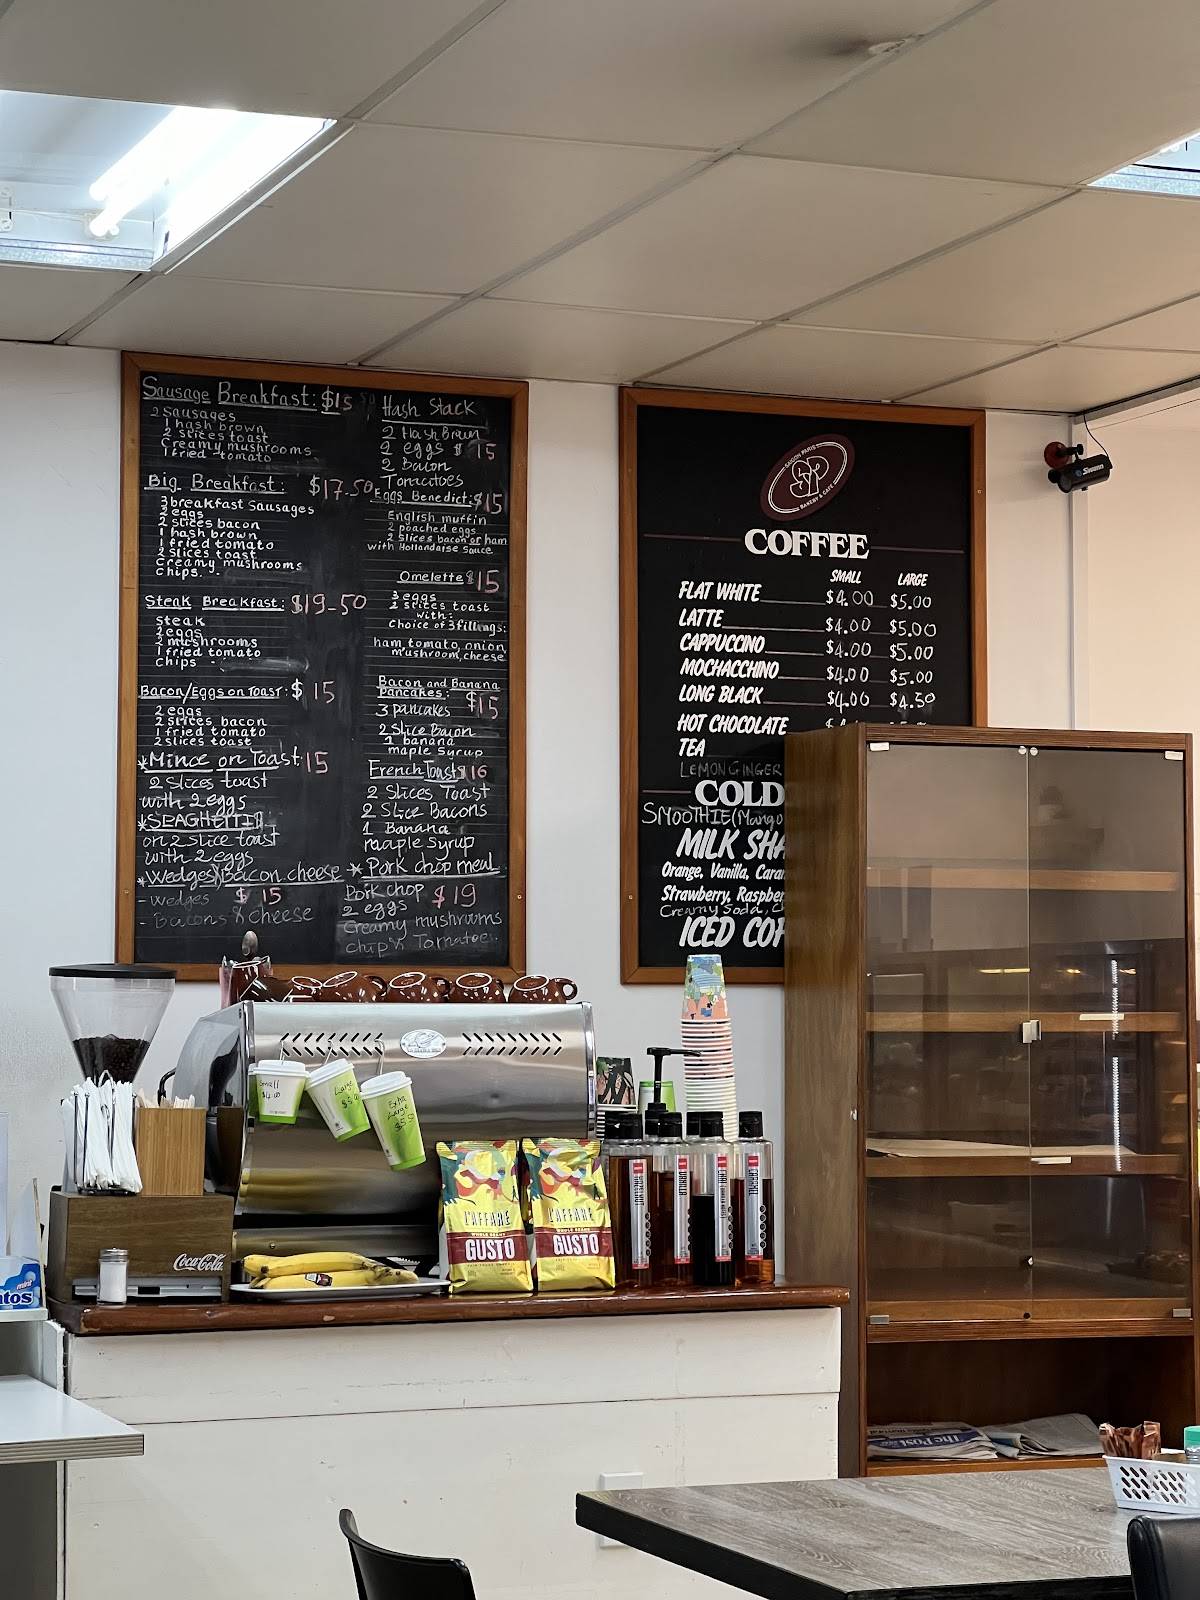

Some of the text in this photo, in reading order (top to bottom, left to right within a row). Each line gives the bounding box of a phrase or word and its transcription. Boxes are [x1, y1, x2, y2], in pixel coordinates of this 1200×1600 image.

[142, 376, 210, 402] Sausage
[382, 395, 477, 419] Hash Stack
[176, 419, 212, 430] hash
[382, 425, 437, 440] 2 Hash
[179, 428, 268, 443] slices toast
[171, 449, 207, 459] fried
[227, 442, 312, 456] mushrooms
[380, 441, 444, 460] 2 eggs
[382, 457, 452, 472] 2 Bacon
[1082, 463, 1104, 476] Swann
[148, 472, 177, 493] Big
[380, 473, 464, 489] Tomatoes
[170, 497, 244, 511] breakfast
[374, 488, 403, 504] Eggs
[171, 508, 204, 520] eggs
[388, 511, 487, 525] English muffin
[171, 517, 260, 530] slices bacon
[399, 524, 476, 538] poached eggs
[170, 527, 258, 540] hash brown
[399, 533, 508, 545] slices bacon ham
[169, 538, 274, 550] fried tomato
[368, 541, 459, 553] with Hollandaise
[744, 528, 869, 560] COFFEE
[215, 550, 257, 560] toast
[223, 558, 303, 571] mushrooms
[400, 571, 465, 582] Omelette
[830, 569, 929, 587] SMALL LARGE
[402, 592, 437, 603] eggs
[678, 580, 762, 602] FLAT WHITE
[826, 589, 874, 607] $4.00
[145, 595, 286, 609] Steak Breakfast:
[403, 601, 490, 612] slices toast
[890, 593, 932, 610] $5.00
[679, 608, 724, 628] LATTE
[825, 617, 871, 635] $4.00
[890, 619, 937, 637] $5.00
[167, 637, 258, 648] mushrooms
[680, 633, 765, 653] CAPPUCCINO
[826, 640, 871, 658] $4.00
[165, 648, 261, 658] fried tomato
[890, 643, 934, 661] $5.00
[680, 658, 780, 680] MOCHACCHINO
[827, 665, 869, 685] $4.00
[890, 668, 933, 686] $5.00
[378, 675, 500, 690] Bacon and Banana
[679, 684, 764, 704] LONG BLACK
[827, 691, 870, 714] $4.00
[890, 692, 936, 710] $4.50
[167, 707, 201, 718] eggs
[376, 703, 389, 717] 3
[168, 716, 267, 726] slices bacon
[677, 713, 789, 735] HOT CHOCOLATE
[165, 727, 266, 737] fried tomato
[430, 723, 477, 738] Bacon
[165, 736, 252, 746] slices toast
[403, 736, 455, 746] banana
[679, 738, 706, 757] TEA
[218, 754, 247, 767] on
[388, 746, 431, 760] maple
[306, 751, 329, 774] 15
[368, 760, 425, 778] French
[728, 760, 783, 777] GINGER
[149, 771, 268, 789] 2 toast
[366, 786, 378, 799] 2
[440, 783, 490, 801] Toast
[695, 780, 785, 807] COLD
[142, 792, 247, 817] with 2 eggs
[361, 803, 376, 819] 2
[430, 802, 488, 819] Bacons
[385, 821, 450, 835] Banana
[143, 836, 167, 848] on
[676, 828, 740, 860] MILK
[145, 849, 254, 870] with 2 eggs
[366, 852, 500, 876] Pork chop meal
[661, 861, 704, 881] Orange,
[710, 862, 750, 880] Vanilla,
[344, 883, 425, 902] Pork chop
[342, 899, 407, 920] 2 eggs
[660, 904, 718, 918] Creamy
[679, 916, 736, 948] ICED
[678, 1171, 688, 1196] VANILLA
[717, 1169, 728, 1184] CHAI
[748, 1169, 759, 1196] CARAMEL
[465, 1238, 515, 1261] GUSTO
[553, 1233, 600, 1256] GUSTO
[173, 1253, 227, 1271] Coca-Cola
[900, 1436, 934, 1448] Post
[935, 1434, 960, 1446] The
